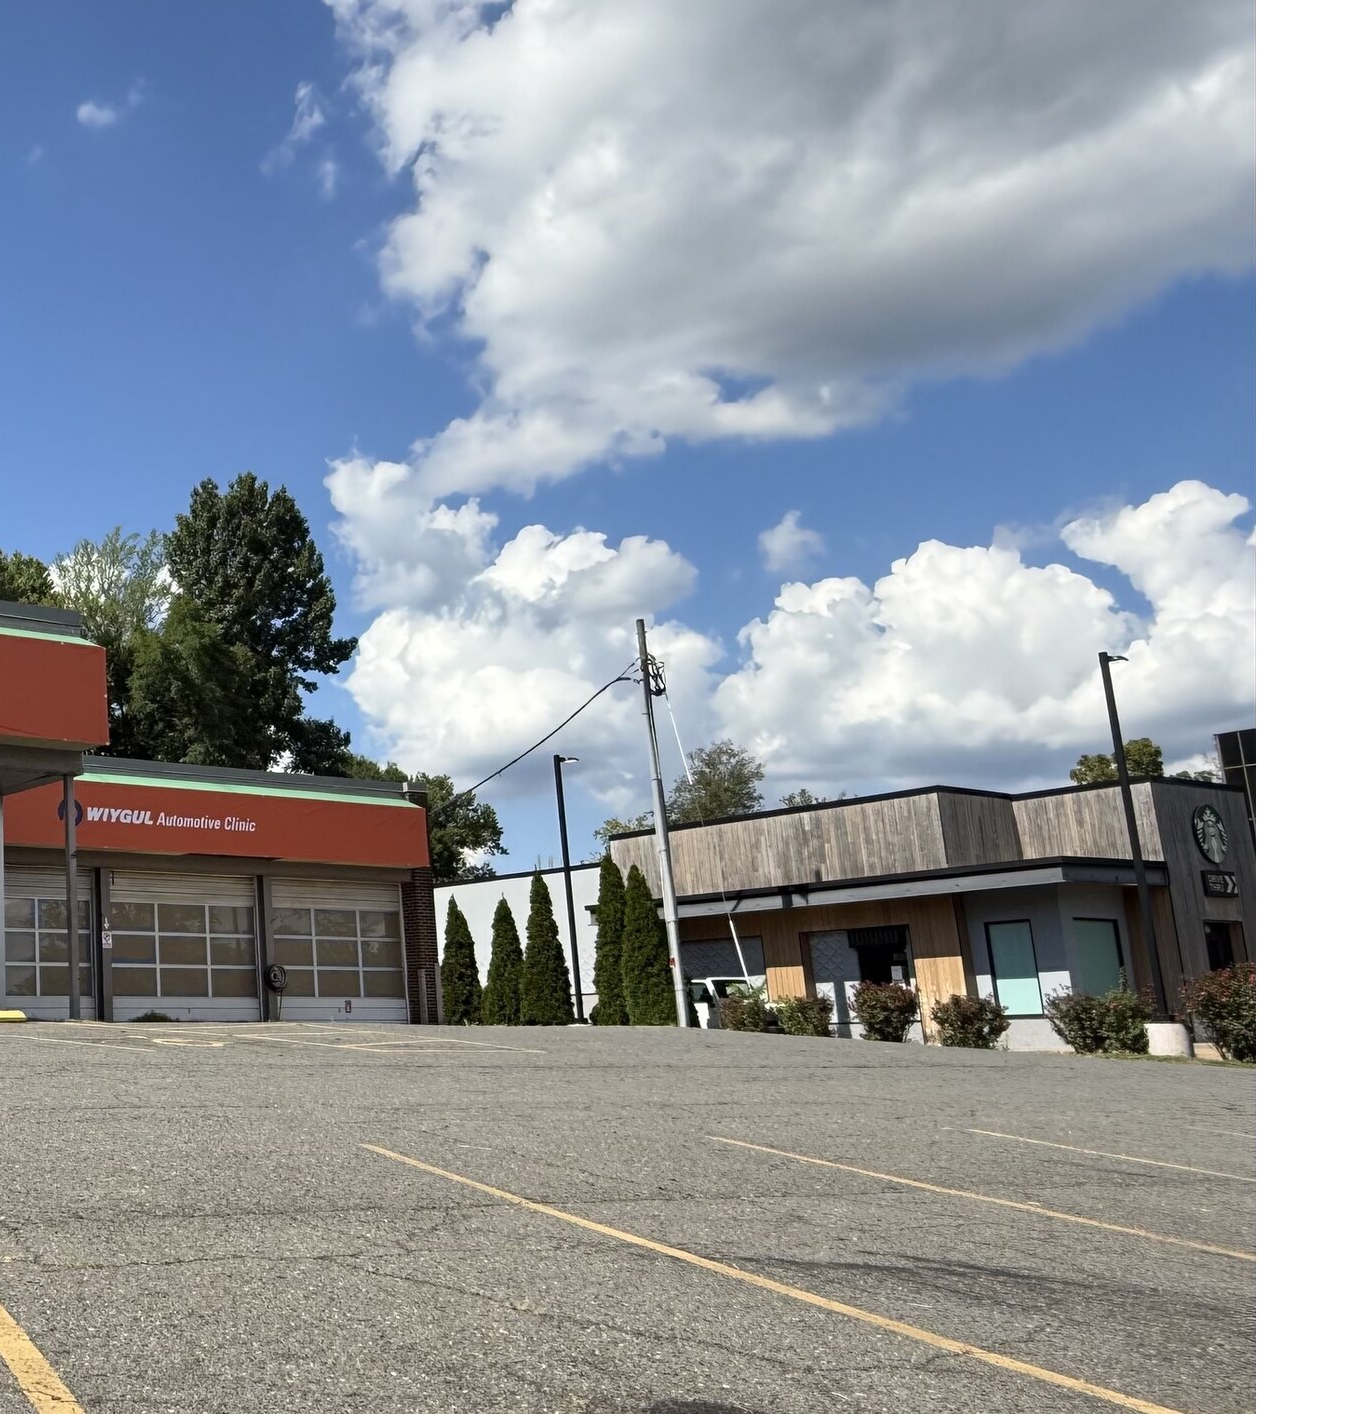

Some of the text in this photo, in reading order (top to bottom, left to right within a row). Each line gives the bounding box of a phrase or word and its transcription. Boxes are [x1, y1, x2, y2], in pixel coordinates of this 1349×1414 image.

[86, 806, 256, 832] WIYGUL Automotive Clinic
